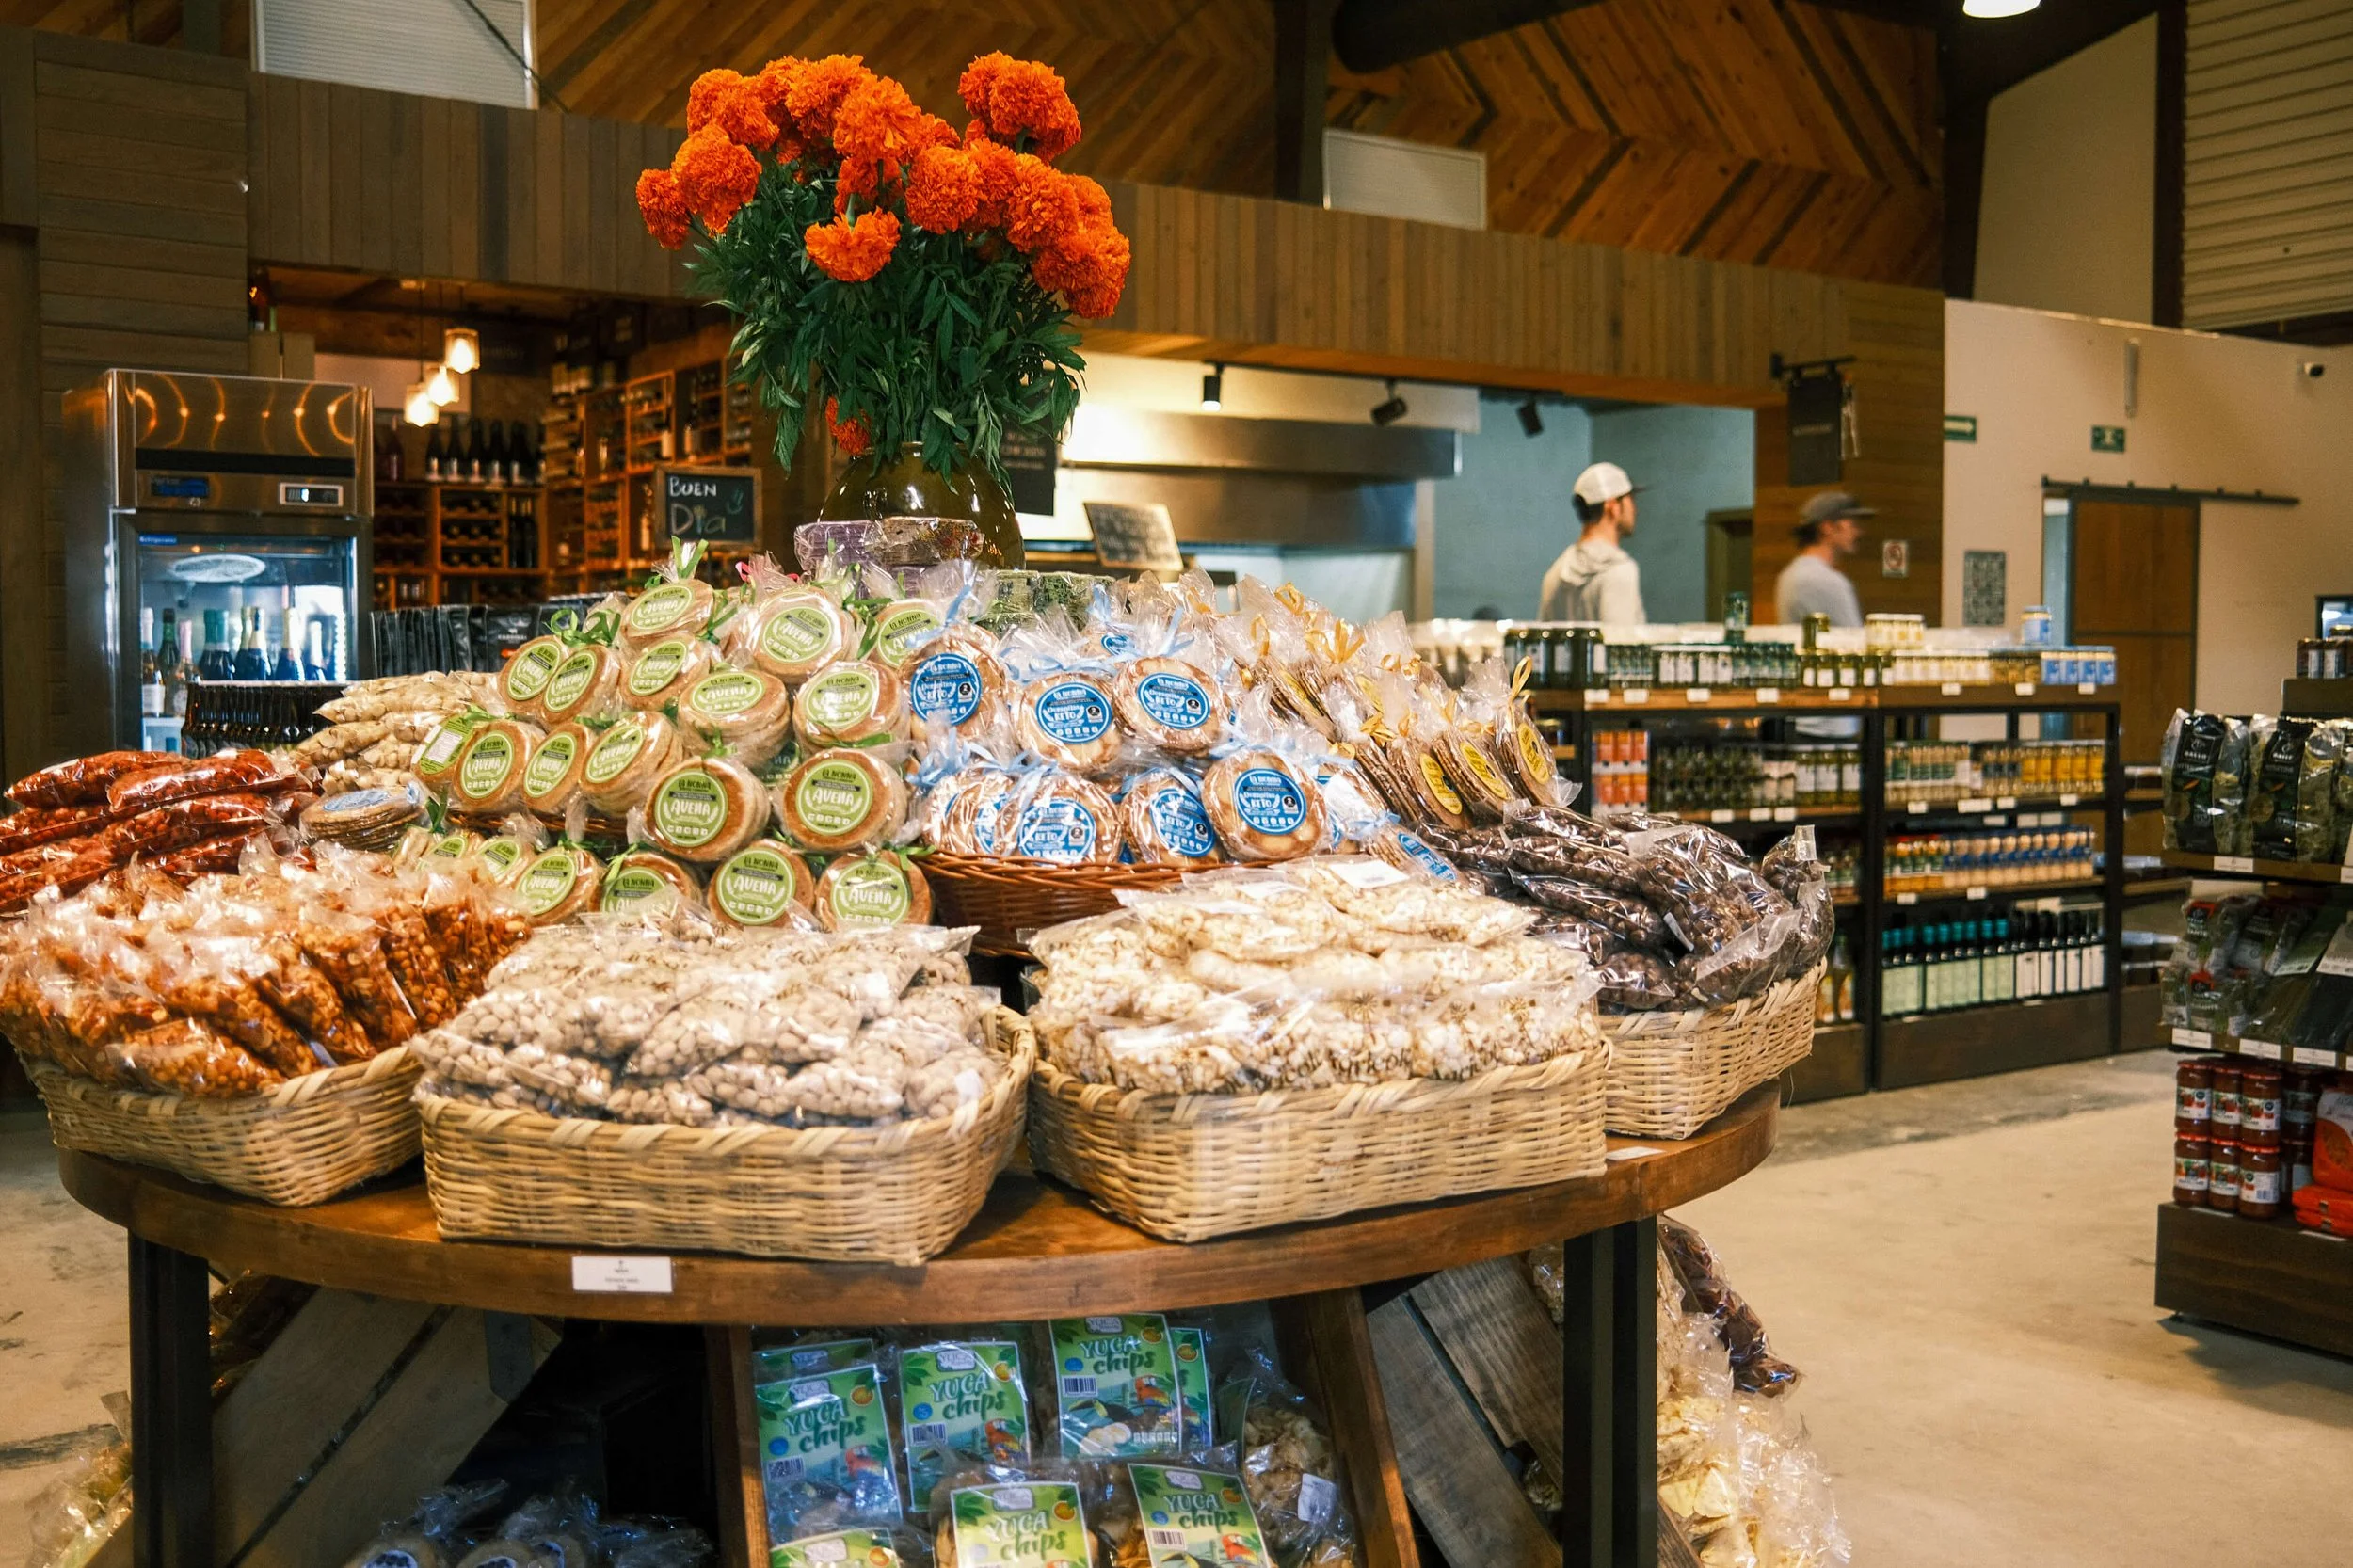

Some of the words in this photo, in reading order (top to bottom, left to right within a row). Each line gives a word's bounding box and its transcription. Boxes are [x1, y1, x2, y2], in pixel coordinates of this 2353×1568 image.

[669, 476, 716, 497] BUEN
[707, 687, 747, 698] AVENA
[671, 799, 711, 816] AVENA
[812, 788, 854, 806] AVENA
[1251, 798, 1272, 808] KETO
[734, 875, 776, 895] AVENA
[849, 888, 892, 904] AVENA
[1080, 1335, 1139, 1358] YUCA
[1093, 1351, 1156, 1376] chips
[929, 1371, 988, 1402] YUCA
[943, 1391, 1005, 1420] chips
[784, 1400, 845, 1435] YUCA
[799, 1416, 866, 1452] chips
[1163, 1494, 1220, 1512] YUCA
[984, 1511, 1048, 1543] YUCA
[1178, 1511, 1238, 1533] chips
[1000, 1530, 1066, 1562] chips
